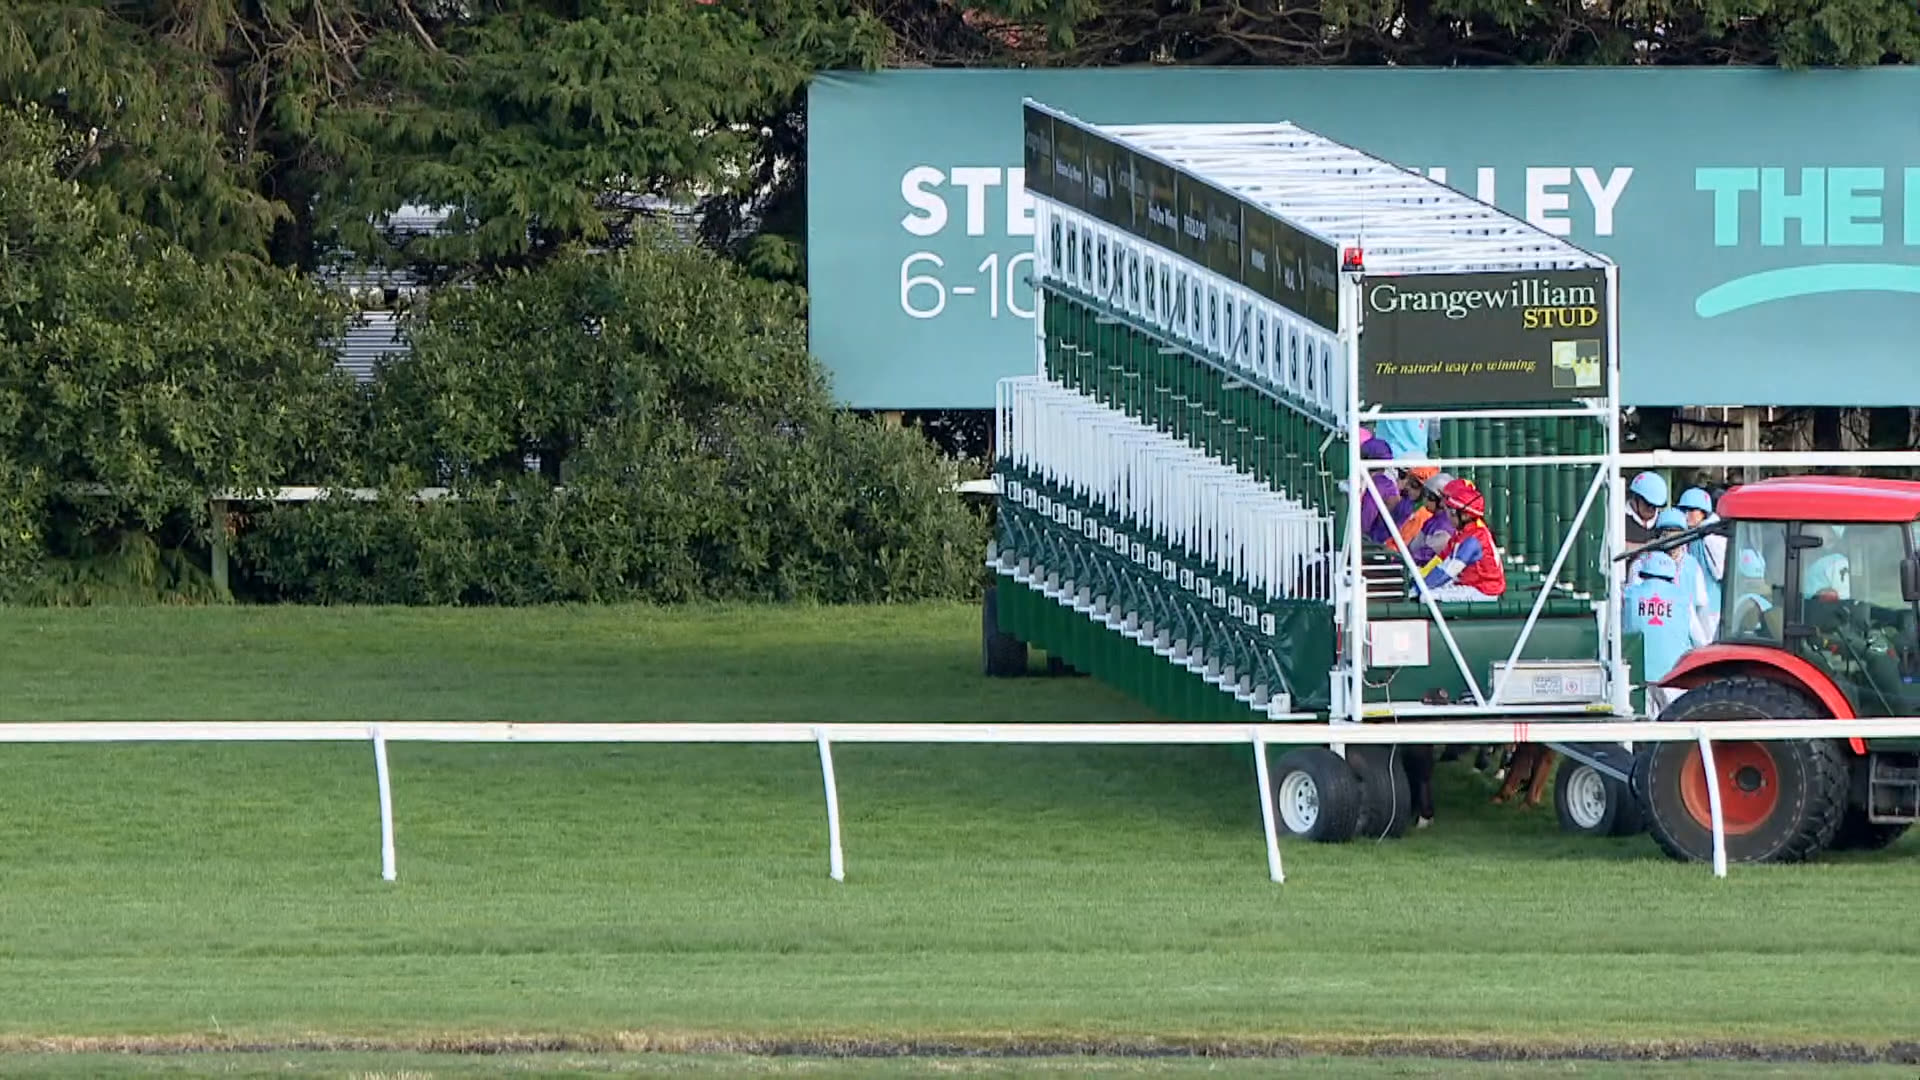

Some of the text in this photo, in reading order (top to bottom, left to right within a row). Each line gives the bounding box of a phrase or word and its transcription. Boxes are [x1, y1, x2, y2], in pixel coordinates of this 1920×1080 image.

[1695, 167, 1884, 246] THE
[1051, 221, 1062, 270] 18
[1067, 226, 1077, 276] 17
[1082, 236, 1092, 282] 16
[1097, 243, 1108, 290] 15
[1129, 256, 1139, 304] 13
[1145, 264, 1156, 312] 12
[1369, 280, 1596, 319] Grangewilliam
[1522, 307, 1599, 329] STUD
[1375, 362, 1398, 376] The
[1400, 361, 1442, 374] natural
[1444, 363, 1468, 376] way
[1471, 360, 1483, 372] to
[1638, 601, 1673, 618] RACE
